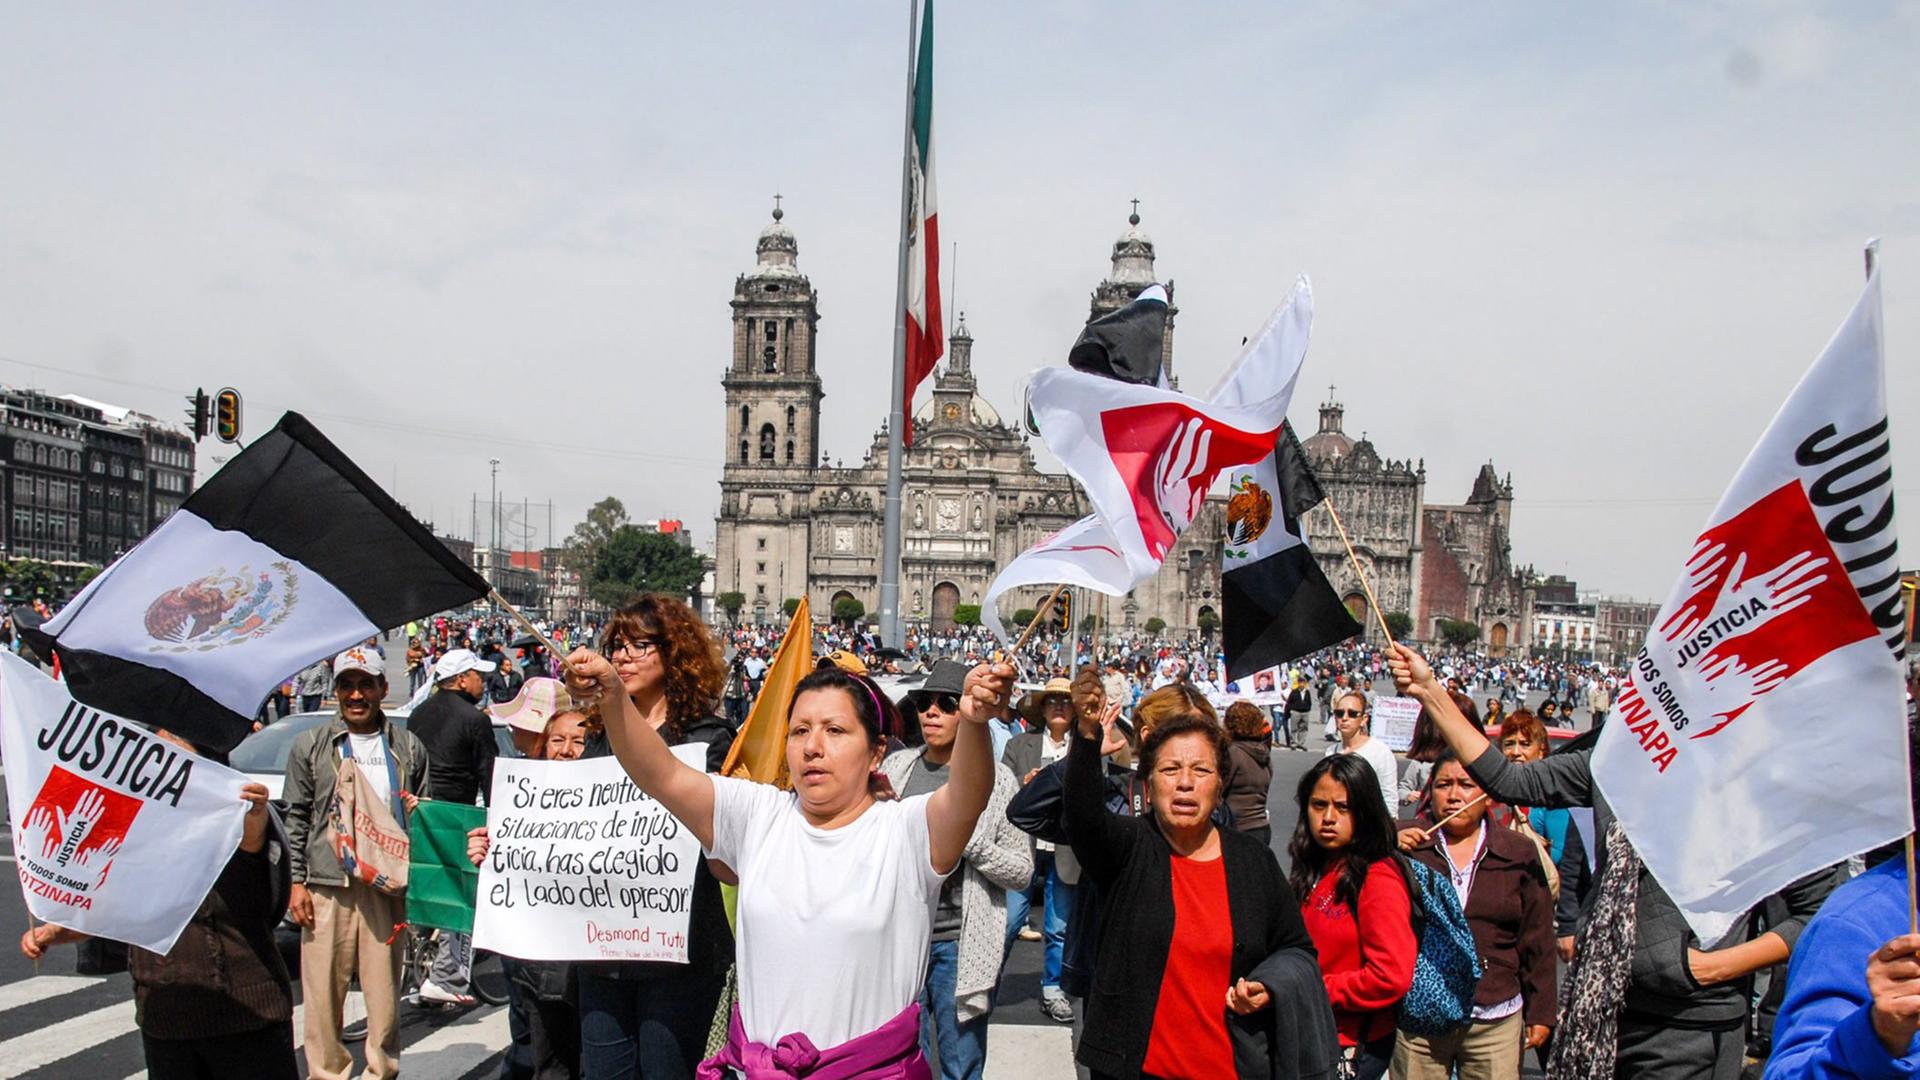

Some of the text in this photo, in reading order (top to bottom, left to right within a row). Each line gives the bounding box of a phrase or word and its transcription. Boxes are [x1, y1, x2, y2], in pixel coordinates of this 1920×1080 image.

[1677, 597, 1768, 668] JUSTICIA
[1652, 682, 1689, 731] SOMOS
[37, 700, 194, 807] JUSTICIA
[540, 787, 583, 809] eres
[588, 776, 652, 807] neutra
[496, 816, 598, 842] situaciones
[601, 810, 627, 839] de
[57, 820, 88, 867] JUSTICIA
[27, 860, 55, 880] TODOS
[55, 875, 89, 891] SOMOS
[492, 843, 678, 879] ticia, has elegido
[490, 877, 515, 908] el
[524, 878, 575, 907] lado
[579, 876, 615, 909] del
[587, 920, 685, 949] Desmond Tutu
